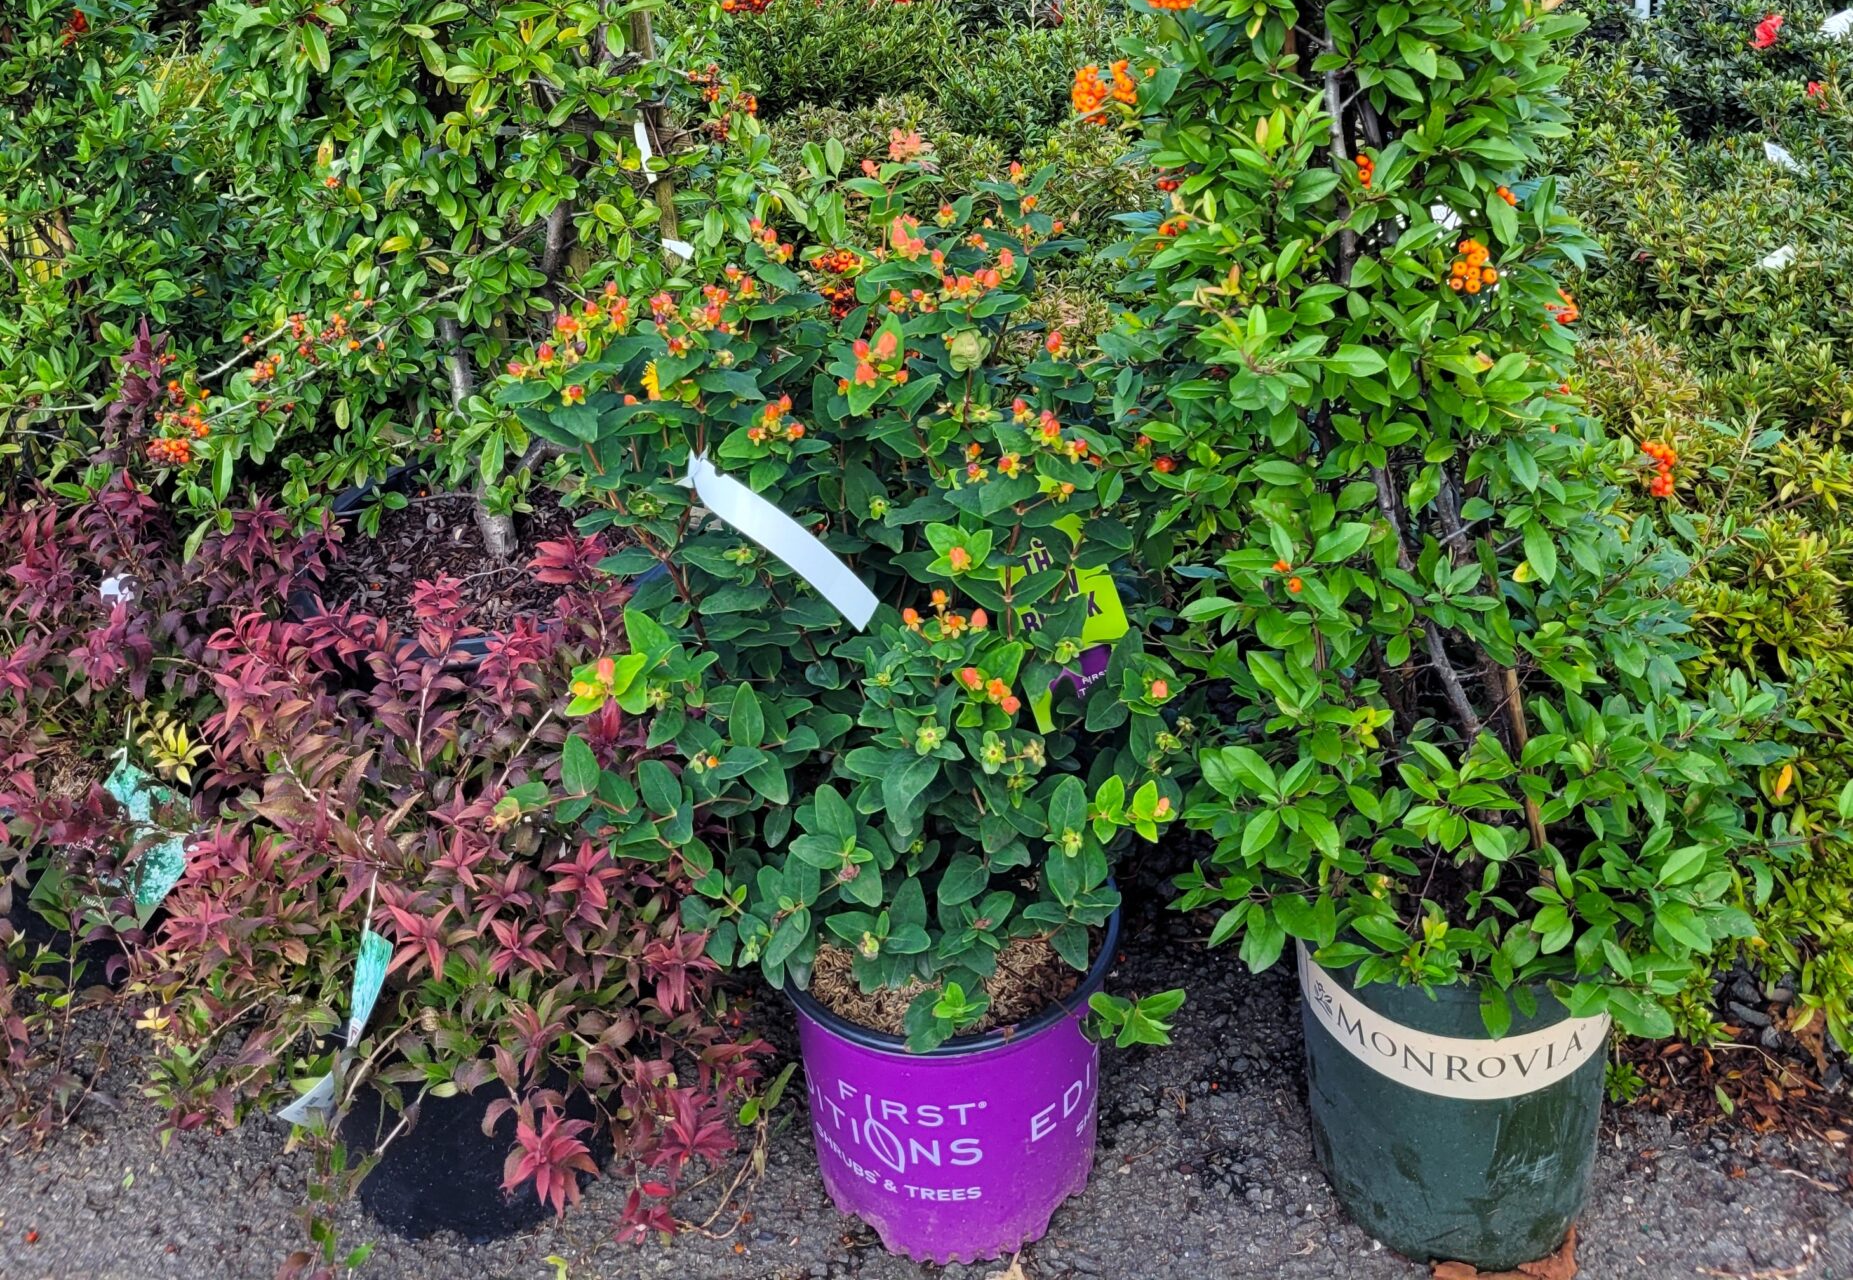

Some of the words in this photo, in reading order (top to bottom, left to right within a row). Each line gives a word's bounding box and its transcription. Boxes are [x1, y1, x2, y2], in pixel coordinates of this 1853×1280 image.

[1337, 1002, 1583, 1083] MONROVIA
[883, 1179, 898, 1193] &
[903, 1184, 982, 1201] TREES
